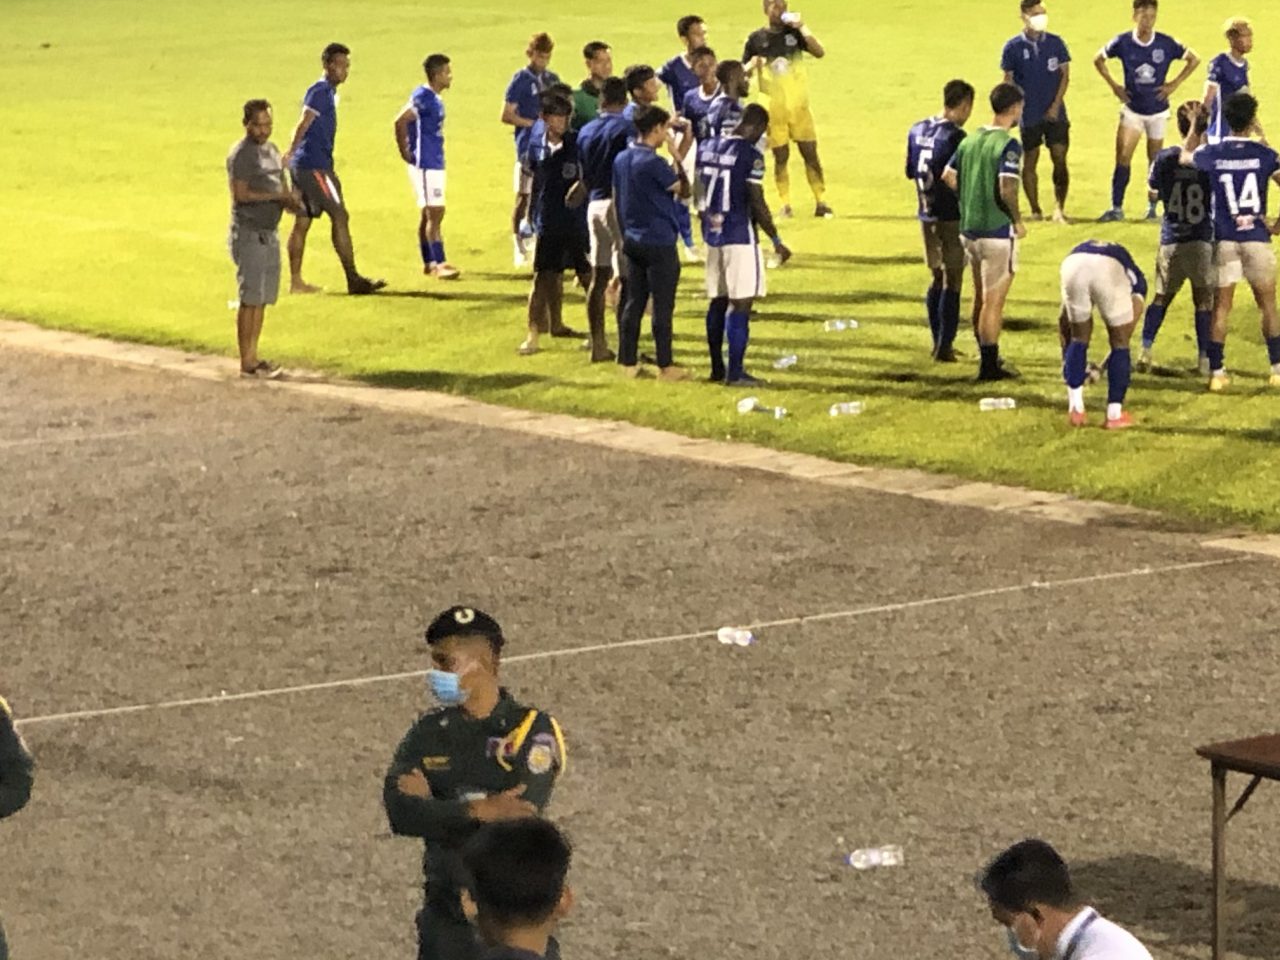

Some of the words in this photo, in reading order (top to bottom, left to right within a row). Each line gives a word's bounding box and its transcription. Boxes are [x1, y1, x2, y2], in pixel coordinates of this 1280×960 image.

[703, 166, 731, 212] 71
[1168, 180, 1205, 224] 48
[1219, 172, 1261, 215] 14
